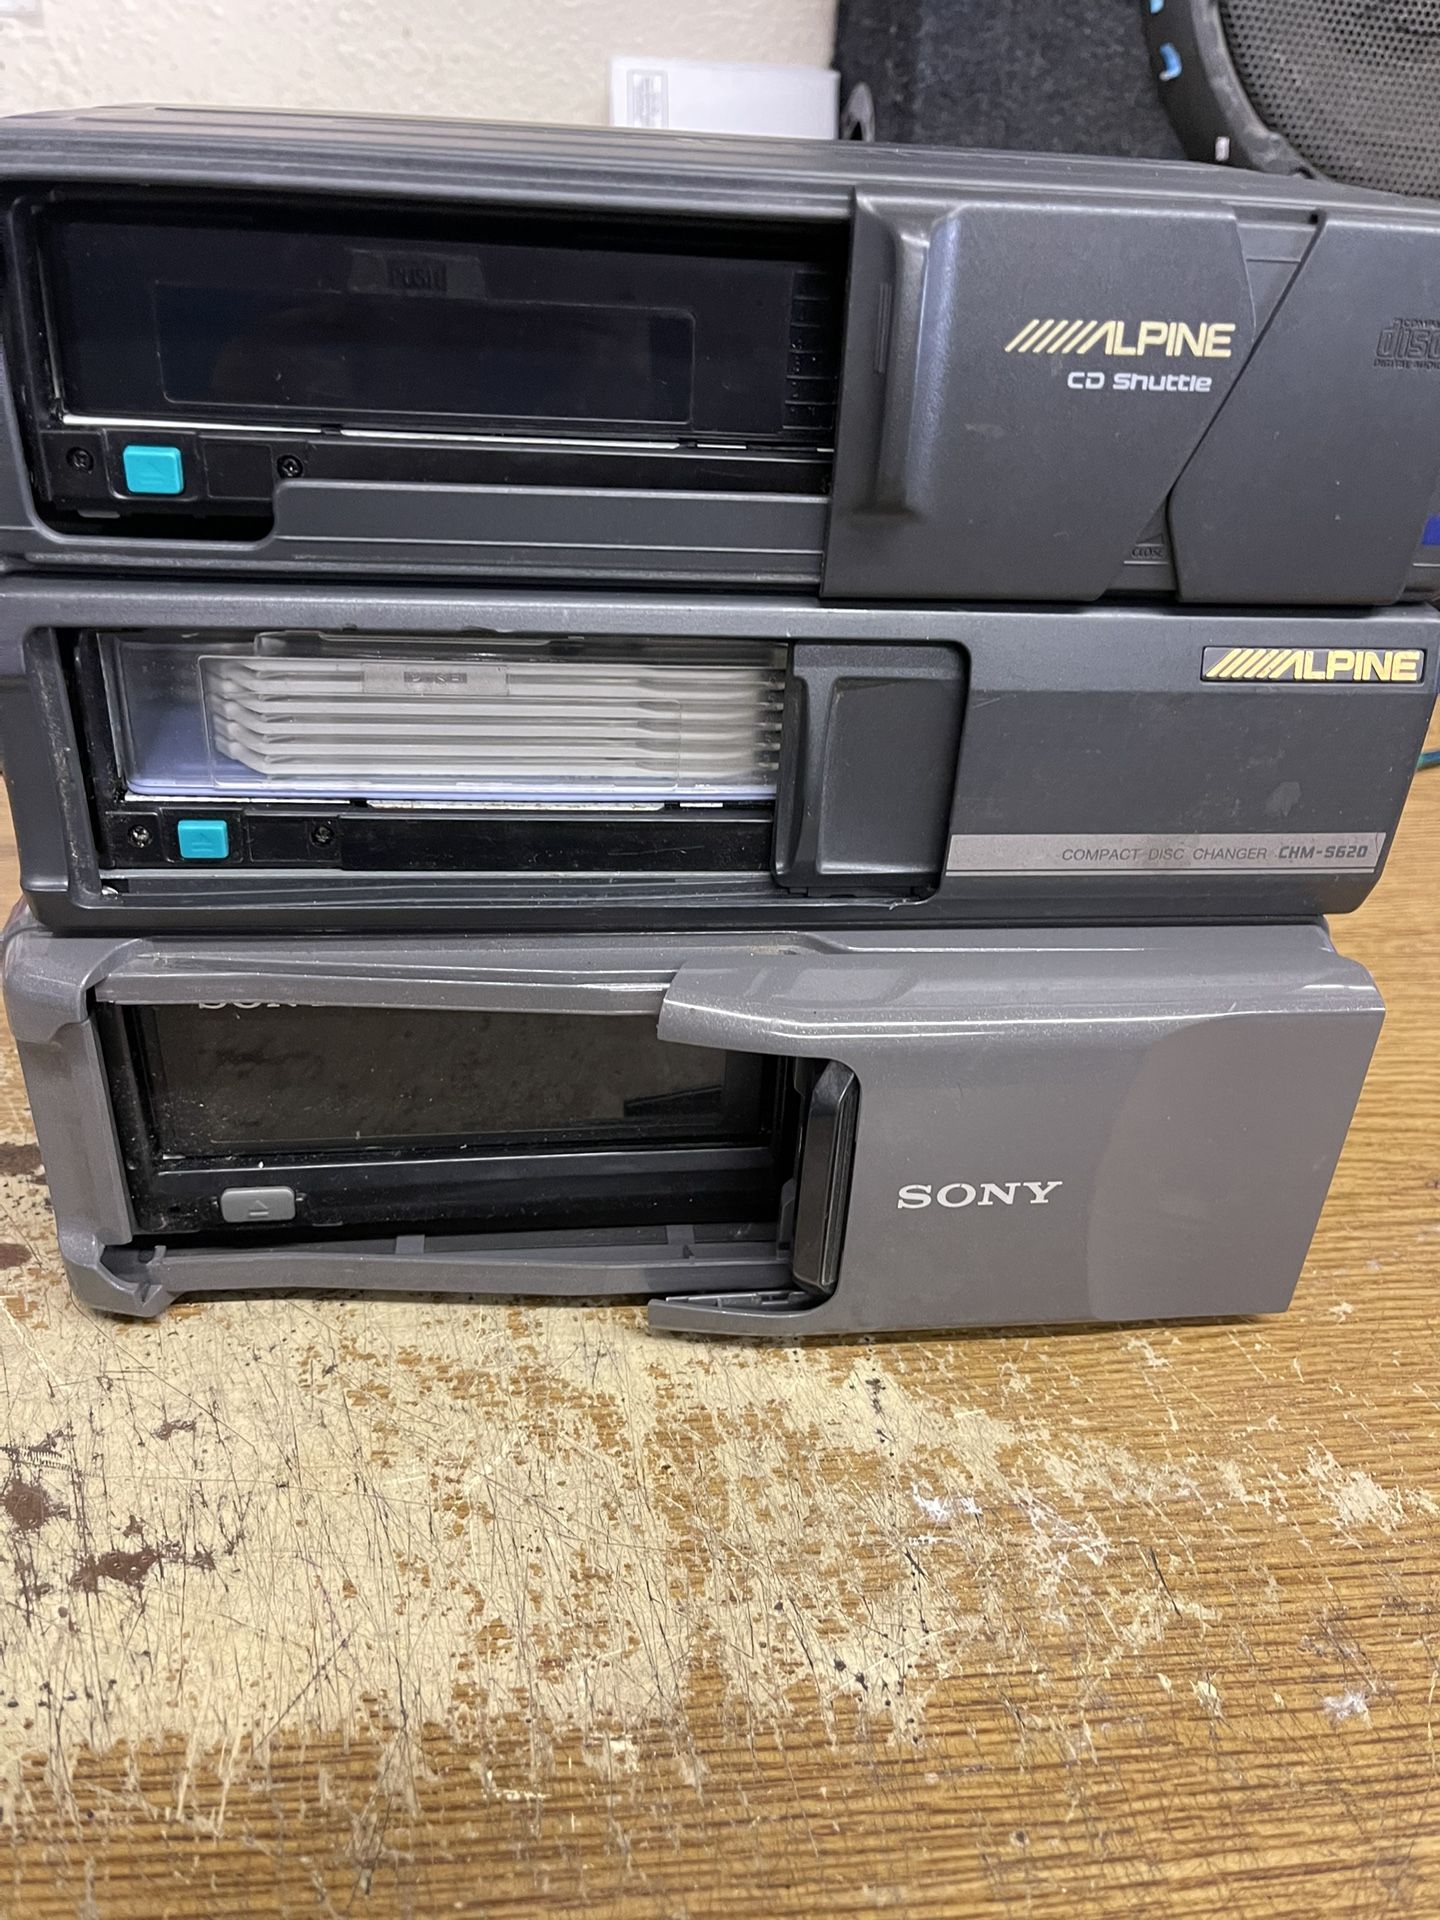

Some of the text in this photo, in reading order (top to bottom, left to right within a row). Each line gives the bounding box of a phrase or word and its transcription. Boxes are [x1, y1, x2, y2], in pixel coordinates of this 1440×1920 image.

[1077, 321, 1236, 358] ALPINE
[1067, 371, 1212, 392] CD Shuttle
[1268, 648, 1420, 682] ALPINE
[1062, 845, 1369, 861] COMPACT DISC CHANGER CHM-S620
[898, 1181, 1063, 1209] SONY
